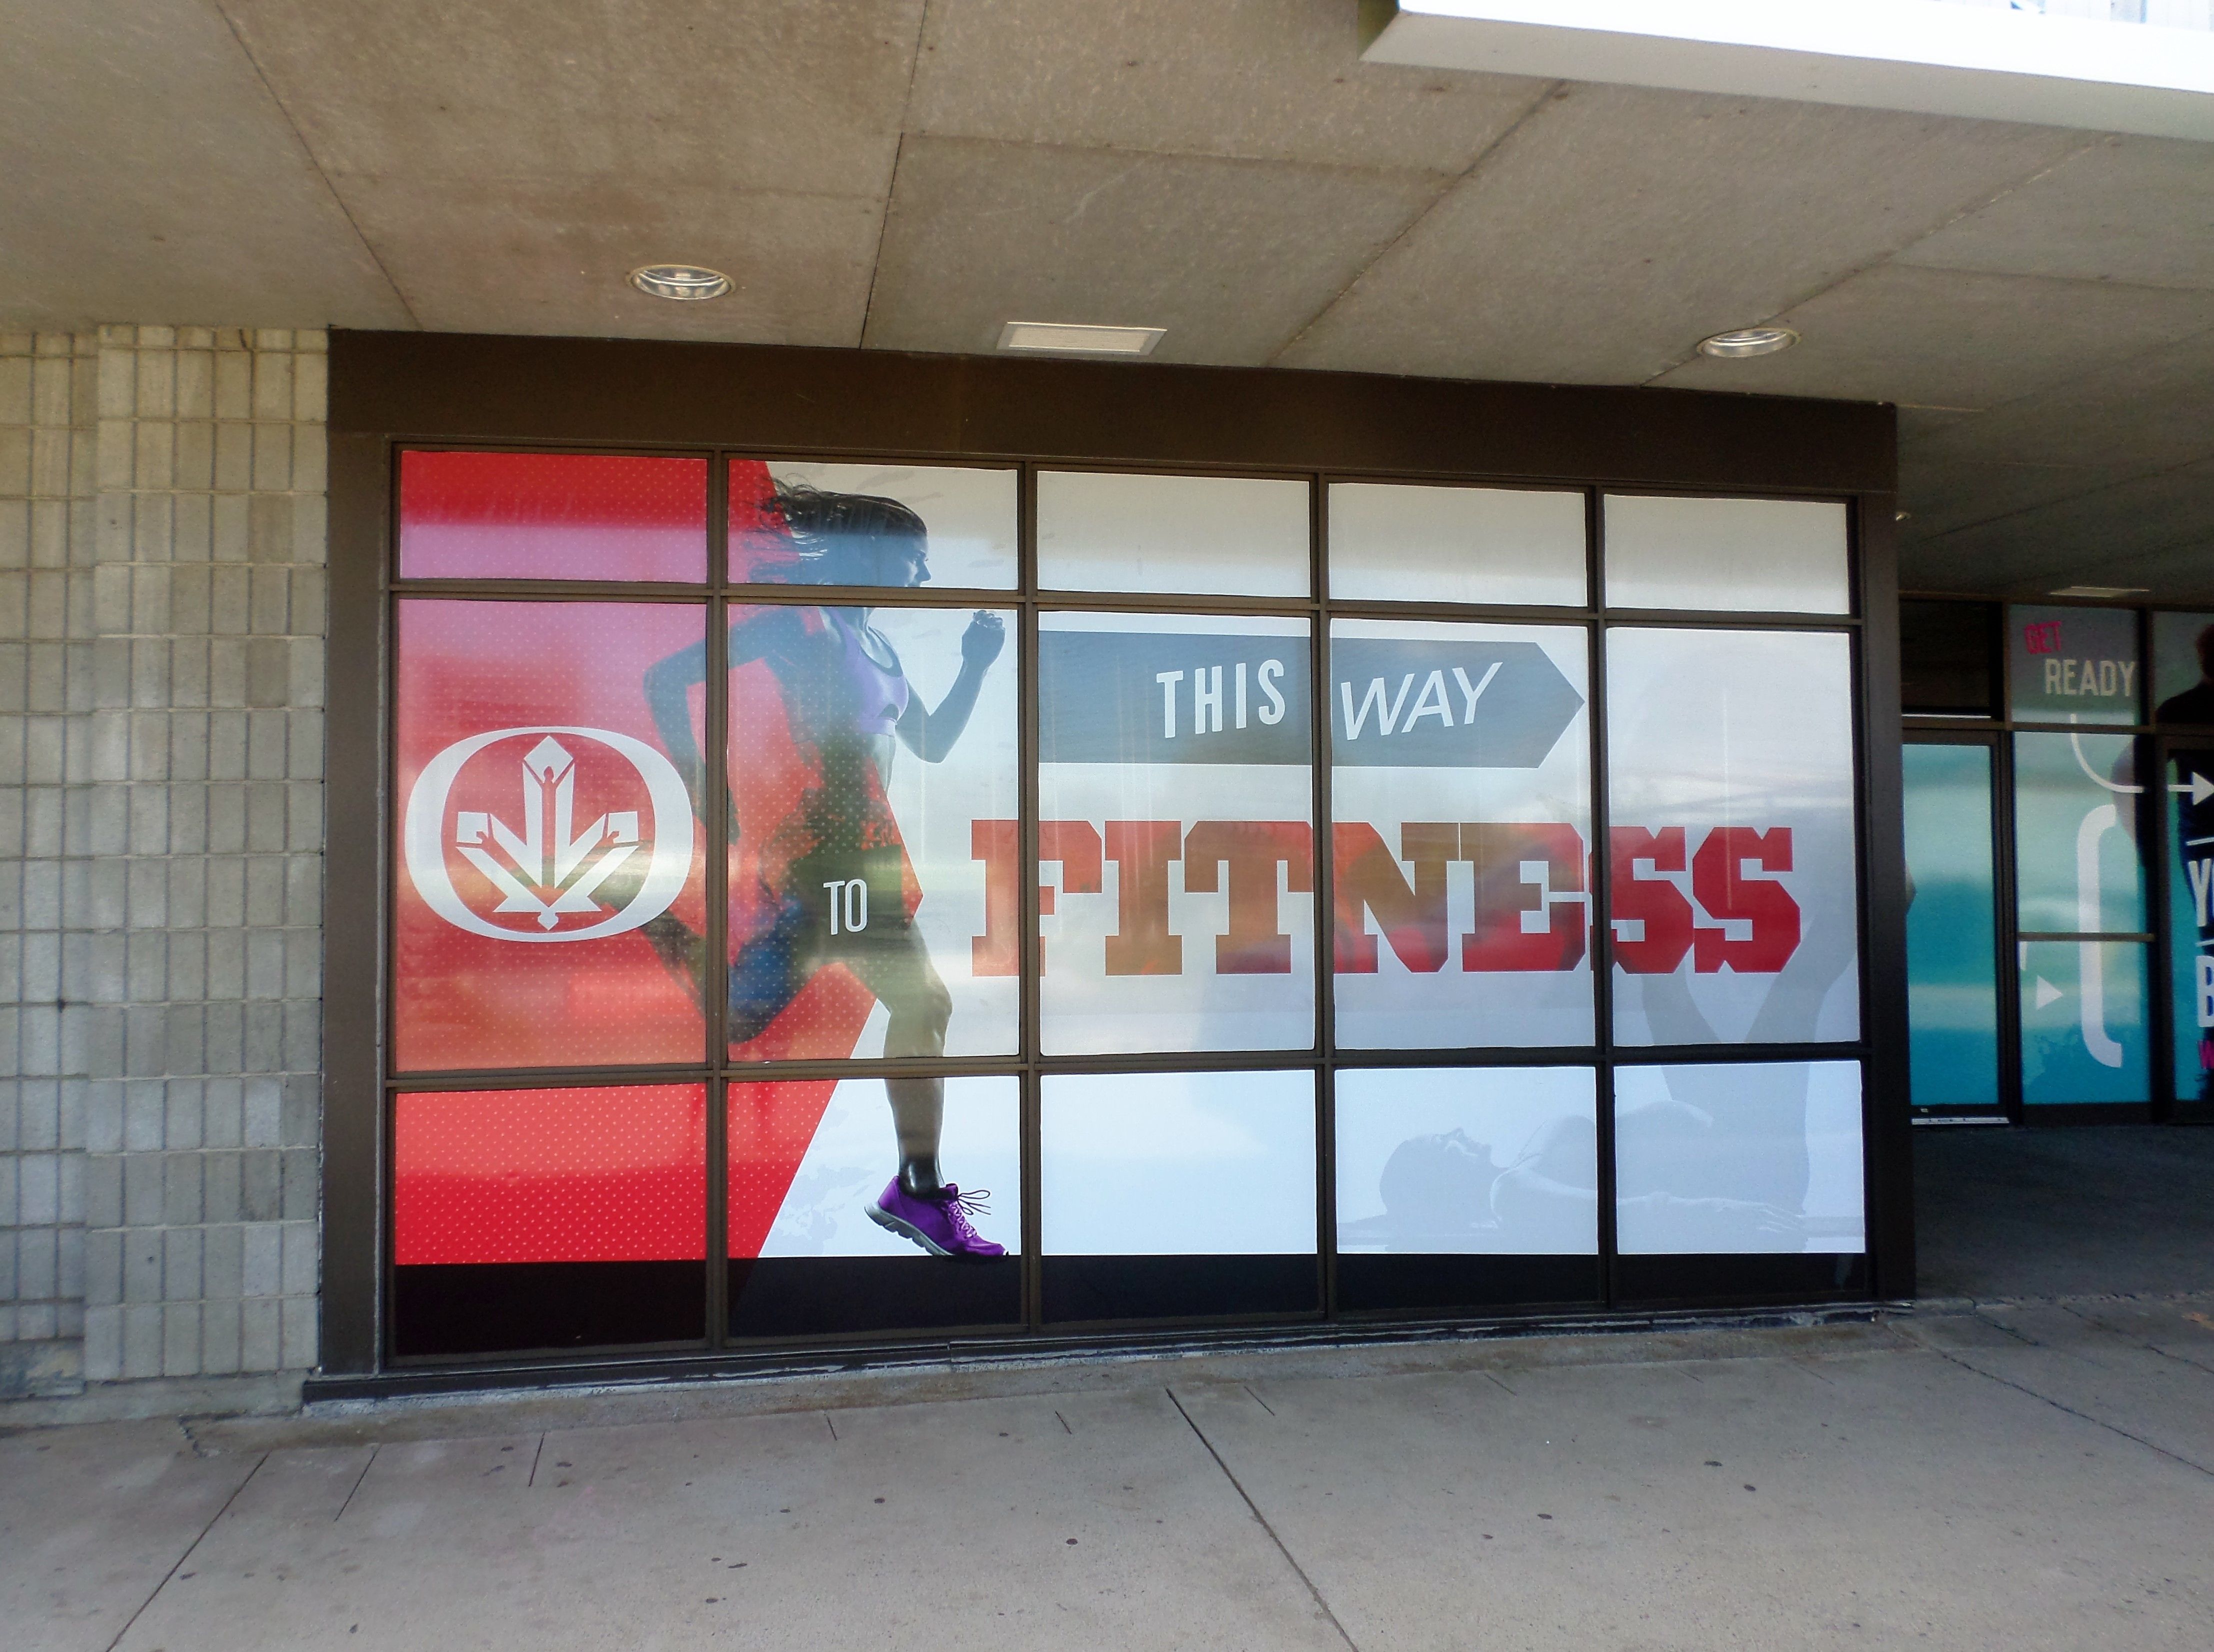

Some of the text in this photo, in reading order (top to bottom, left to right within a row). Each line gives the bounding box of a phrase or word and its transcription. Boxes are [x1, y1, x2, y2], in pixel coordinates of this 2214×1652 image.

[2024, 620, 2062, 655] GET
[1156, 659, 1503, 741] THIS WAY
[2045, 658, 2136, 697] READY
[823, 819, 1801, 977] TO FITNESS
